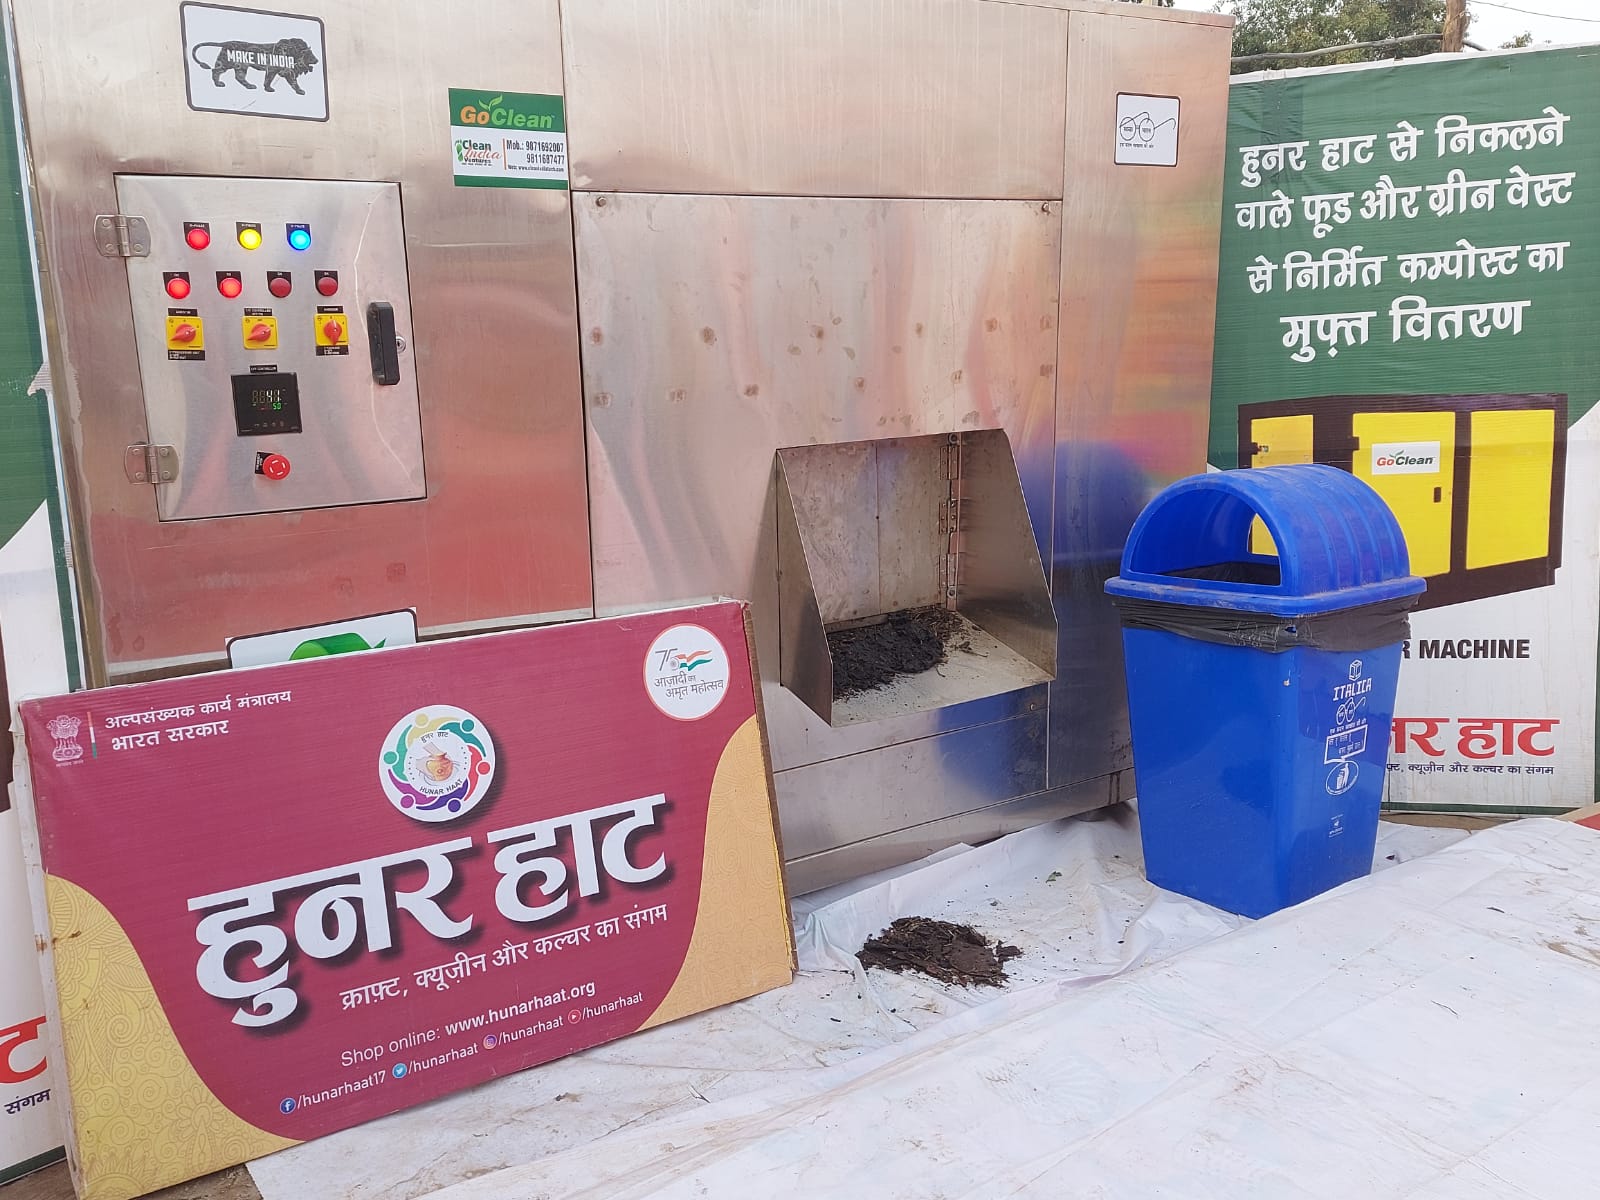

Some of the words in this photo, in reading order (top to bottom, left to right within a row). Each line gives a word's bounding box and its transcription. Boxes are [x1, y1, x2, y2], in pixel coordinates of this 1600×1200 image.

[226, 49, 256, 64] MAKE
[257, 52, 267, 65] IN
[269, 54, 295, 69] INDIA
[460, 105, 553, 129] GoClean
[462, 139, 492, 152] Clean
[464, 145, 502, 160] India
[1239, 140, 1309, 188] हुनर
[1318, 134, 1377, 172] हाट
[1386, 120, 1424, 162] से
[1434, 106, 1571, 158] निकलने
[1235, 189, 1294, 231] वाले
[1301, 191, 1355, 239] फूड
[1359, 174, 1422, 221] और
[1425, 168, 1502, 218] ग्रीन
[1505, 164, 1576, 209] वेस्ट
[1246, 254, 1278, 294] से
[1282, 245, 1388, 292] निर्मित
[1396, 238, 1522, 283] कम्पोस्ट
[1525, 241, 1571, 273] का
[1388, 295, 1531, 344] वितरण
[1376, 455, 1435, 467] GoClean
[1418, 639, 1530, 659] MACHINE
[665, 685, 689, 701] अमृत
[691, 679, 724, 695] महोत्सव
[1332, 677, 1373, 702] ITALICA
[104, 704, 195, 729] अल्पसंख्यक
[199, 695, 232, 715] कार्य
[235, 689, 292, 709] मंत्रालय
[111, 730, 160, 751] भारत
[166, 719, 230, 743] सरकार
[1457, 718, 1560, 759] हाट
[1448, 761, 1469, 773] और
[1472, 764, 1506, 774] कल्चर
[1508, 764, 1521, 774] का
[1525, 763, 1554, 775] संगम
[419, 785, 445, 796] HUNAR
[446, 778, 463, 793] HAAT
[187, 836, 474, 1028] हुनर
[487, 793, 667, 923] हाट
[491, 939, 529, 966] और
[533, 924, 591, 955] कल्चर
[595, 916, 621, 939] का
[623, 903, 667, 930] संगम
[341, 1043, 384, 1067] Shop
[388, 1027, 441, 1053] online:
[444, 980, 596, 1036] www.hunarhaat.org
[297, 1070, 386, 1109] /hunarhaat17
[408, 1043, 479, 1074] /hunarhaat
[498, 1015, 564, 1045] /hunarhaat
[582, 991, 643, 1020] /hunarhaat
[4, 1088, 51, 1115] संगम
